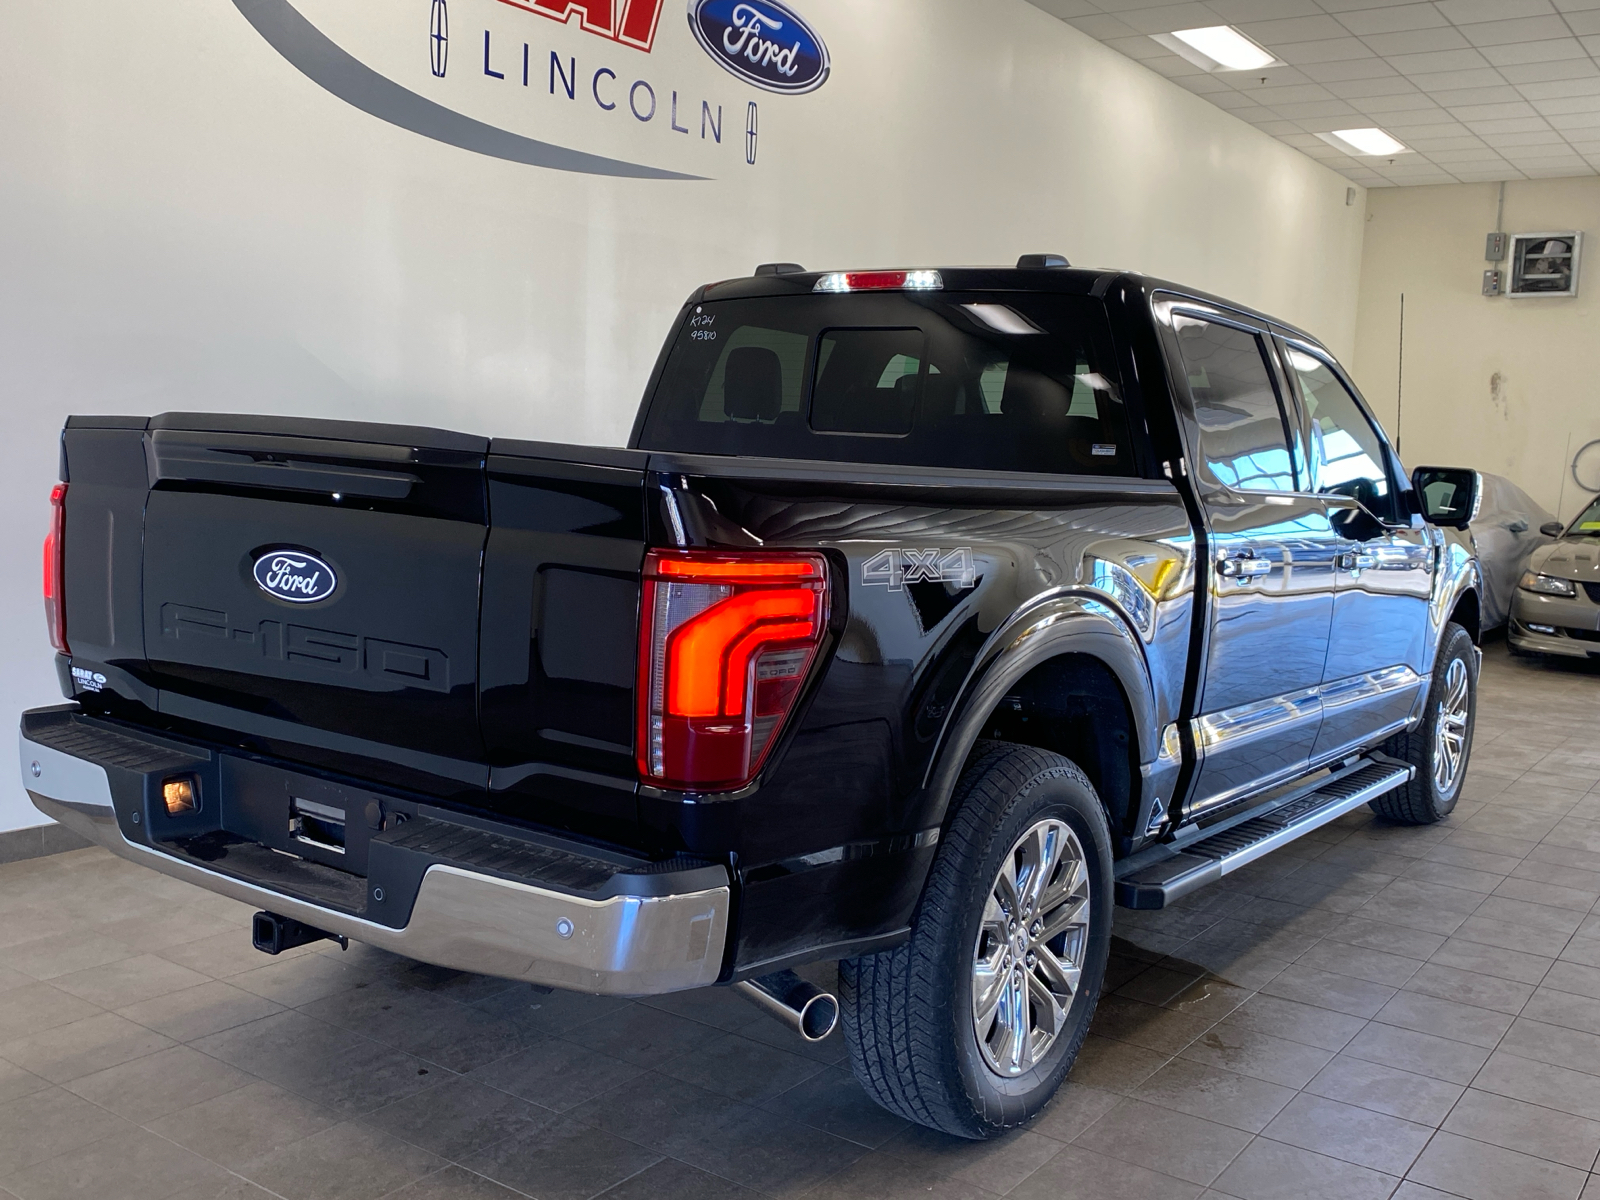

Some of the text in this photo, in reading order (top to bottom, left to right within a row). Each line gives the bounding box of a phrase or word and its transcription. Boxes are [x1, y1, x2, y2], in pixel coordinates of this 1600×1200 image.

[723, 3, 799, 77] Ford
[484, 30, 722, 143] LINCOLN
[266, 557, 319, 594] Ford
[160, 602, 450, 694] F-150
